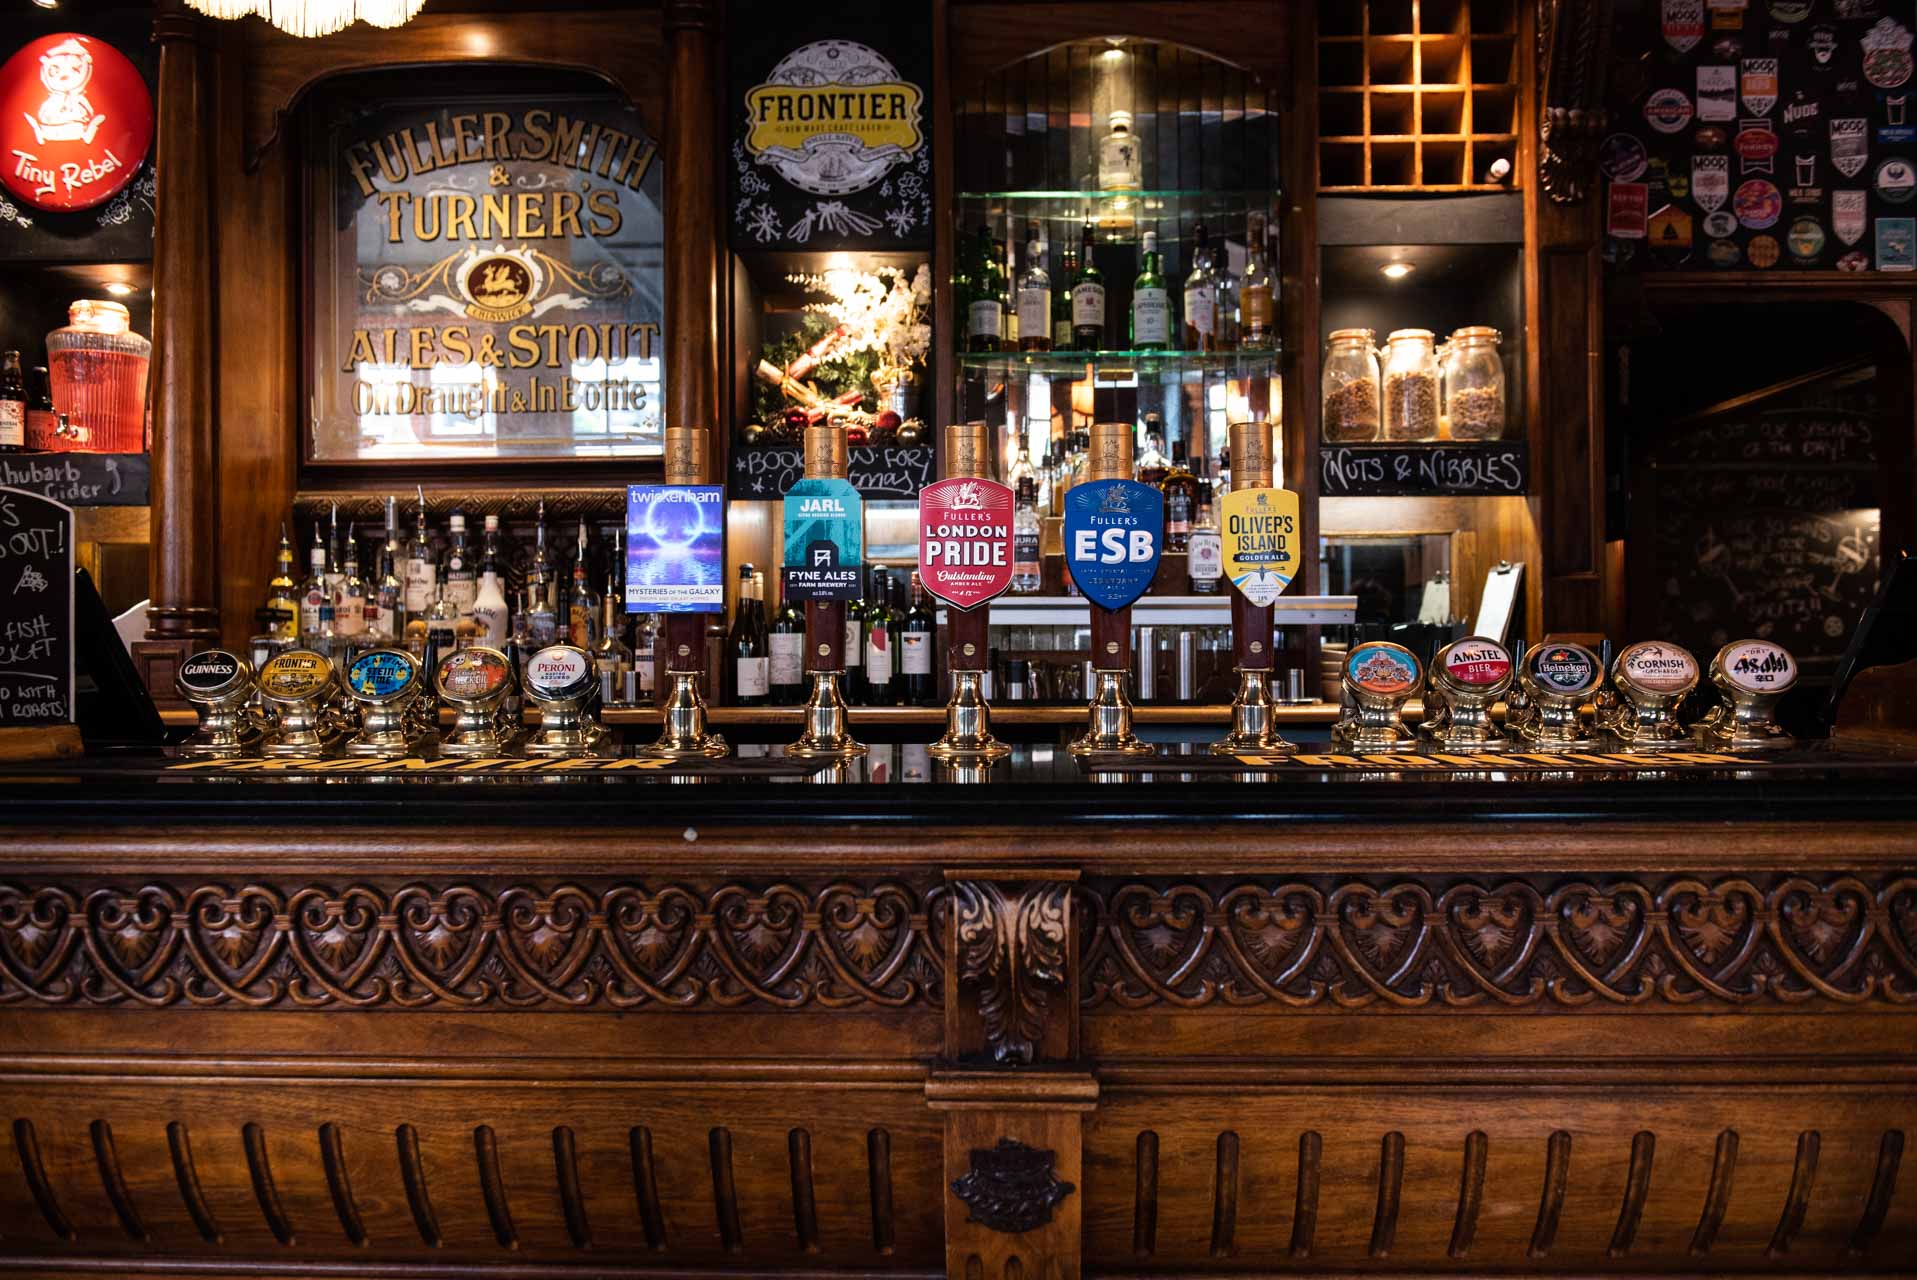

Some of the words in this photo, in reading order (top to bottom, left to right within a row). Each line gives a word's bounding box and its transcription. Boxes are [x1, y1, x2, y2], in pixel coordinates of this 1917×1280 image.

[758, 93, 907, 122] FRONTIER
[523, 109, 657, 192] SMITH
[12, 149, 55, 195] Tiny
[61, 149, 122, 190] Rebel
[488, 163, 511, 188] &
[377, 180, 624, 243] TURNER'S
[341, 325, 474, 373] ALES
[475, 333, 506, 369] &
[507, 323, 662, 369] STOUT
[529, 376, 558, 413] In
[0, 460, 81, 485] hubarb
[1394, 454, 1413, 481] &
[631, 489, 721, 503] twickenham
[800, 498, 845, 512] JARL
[943, 512, 992, 521] FULLER'S
[1090, 515, 1138, 525] FULLER'S
[1229, 514, 1294, 535] OLIVER'S
[926, 524, 1008, 539] LONDON
[1074, 528, 1154, 565] ESB
[1237, 534, 1286, 551] ISLAND
[925, 541, 1008, 567] PRIDE
[789, 571, 821, 581] FYNE
[824, 571, 857, 581] ALES
[936, 569, 996, 584] Outstanding
[1453, 650, 1501, 664] AMSTEL
[1637, 659, 1685, 669] CORNISH
[1733, 651, 1788, 674] Asahi
[184, 664, 233, 675] GUINNESS
[538, 663, 576, 672] PERONI
[1468, 664, 1492, 673] BIER
[1542, 663, 1588, 674] Heineken
